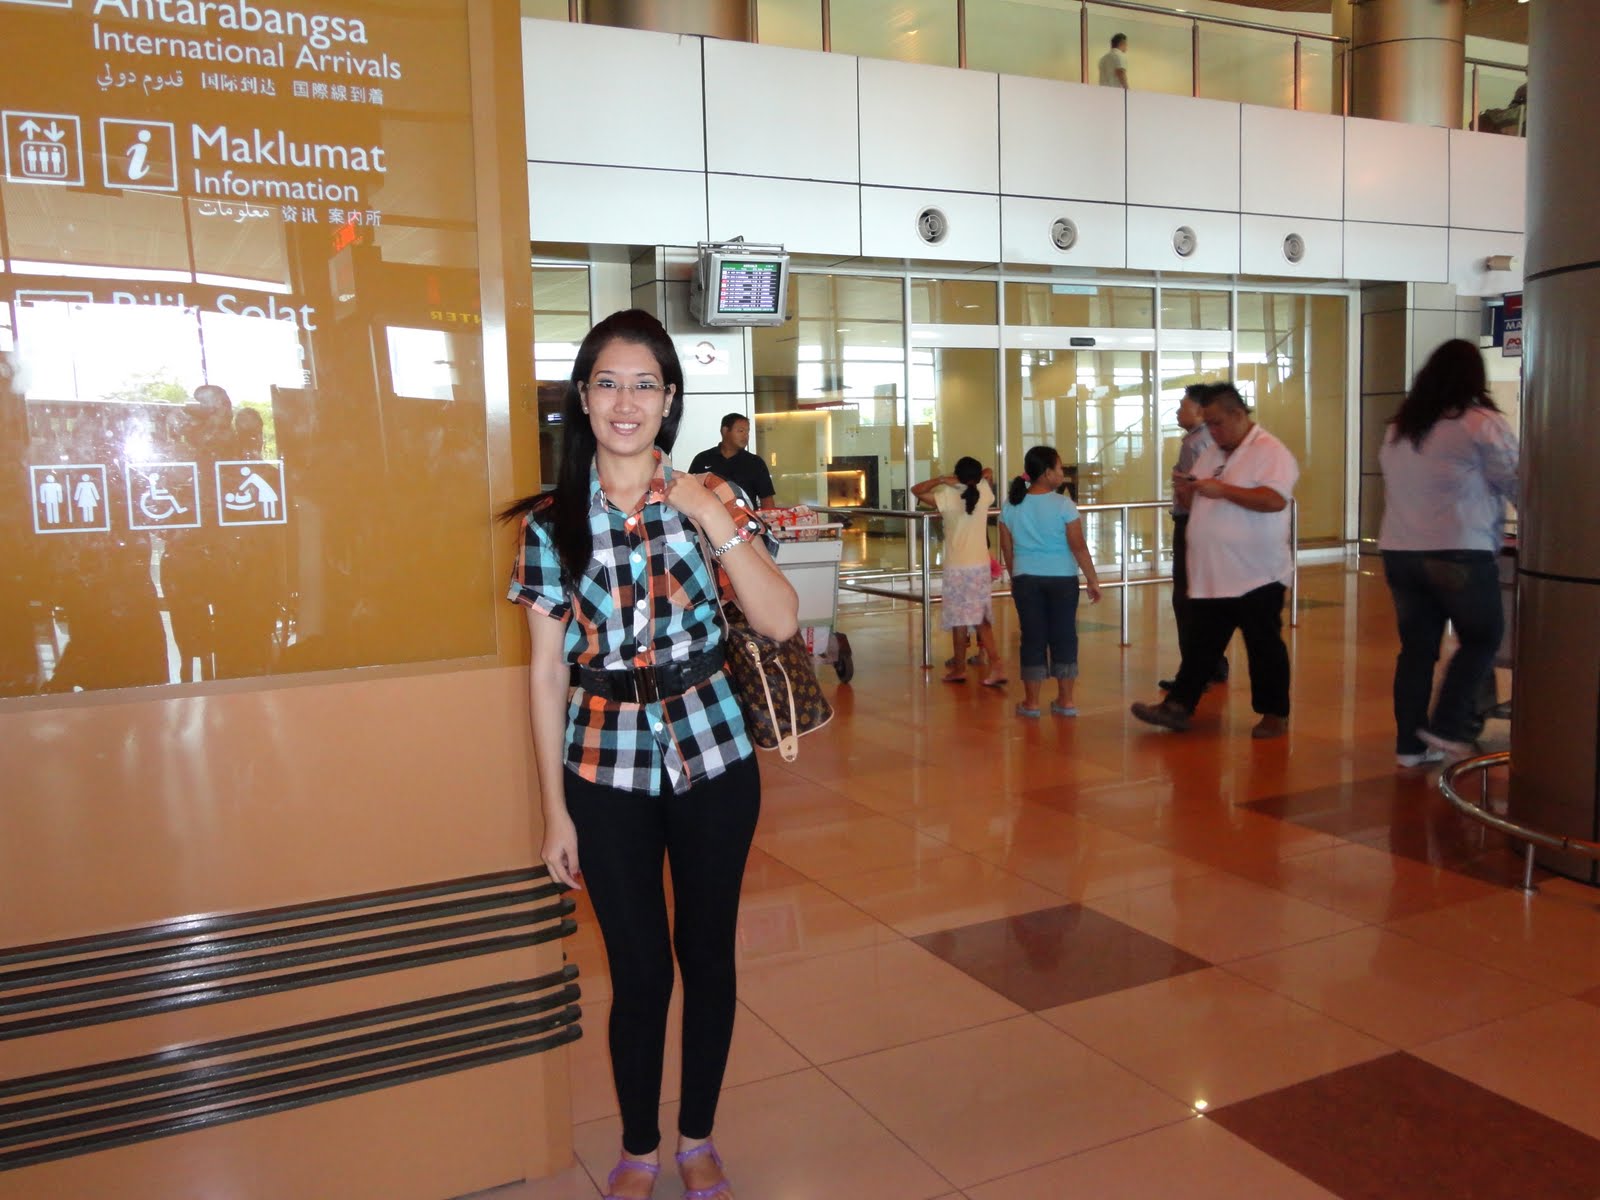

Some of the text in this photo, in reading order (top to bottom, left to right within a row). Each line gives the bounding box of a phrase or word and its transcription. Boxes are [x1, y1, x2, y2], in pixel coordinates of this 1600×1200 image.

[93, 22, 403, 80] International Arrivals
[201, 72, 276, 96] 国际到达
[293, 80, 384, 105] 国際線到着
[191, 123, 387, 173] Maklumat
[194, 168, 359, 202] Information
[281, 205, 318, 223] 资讯
[328, 208, 382, 227] 案内所
